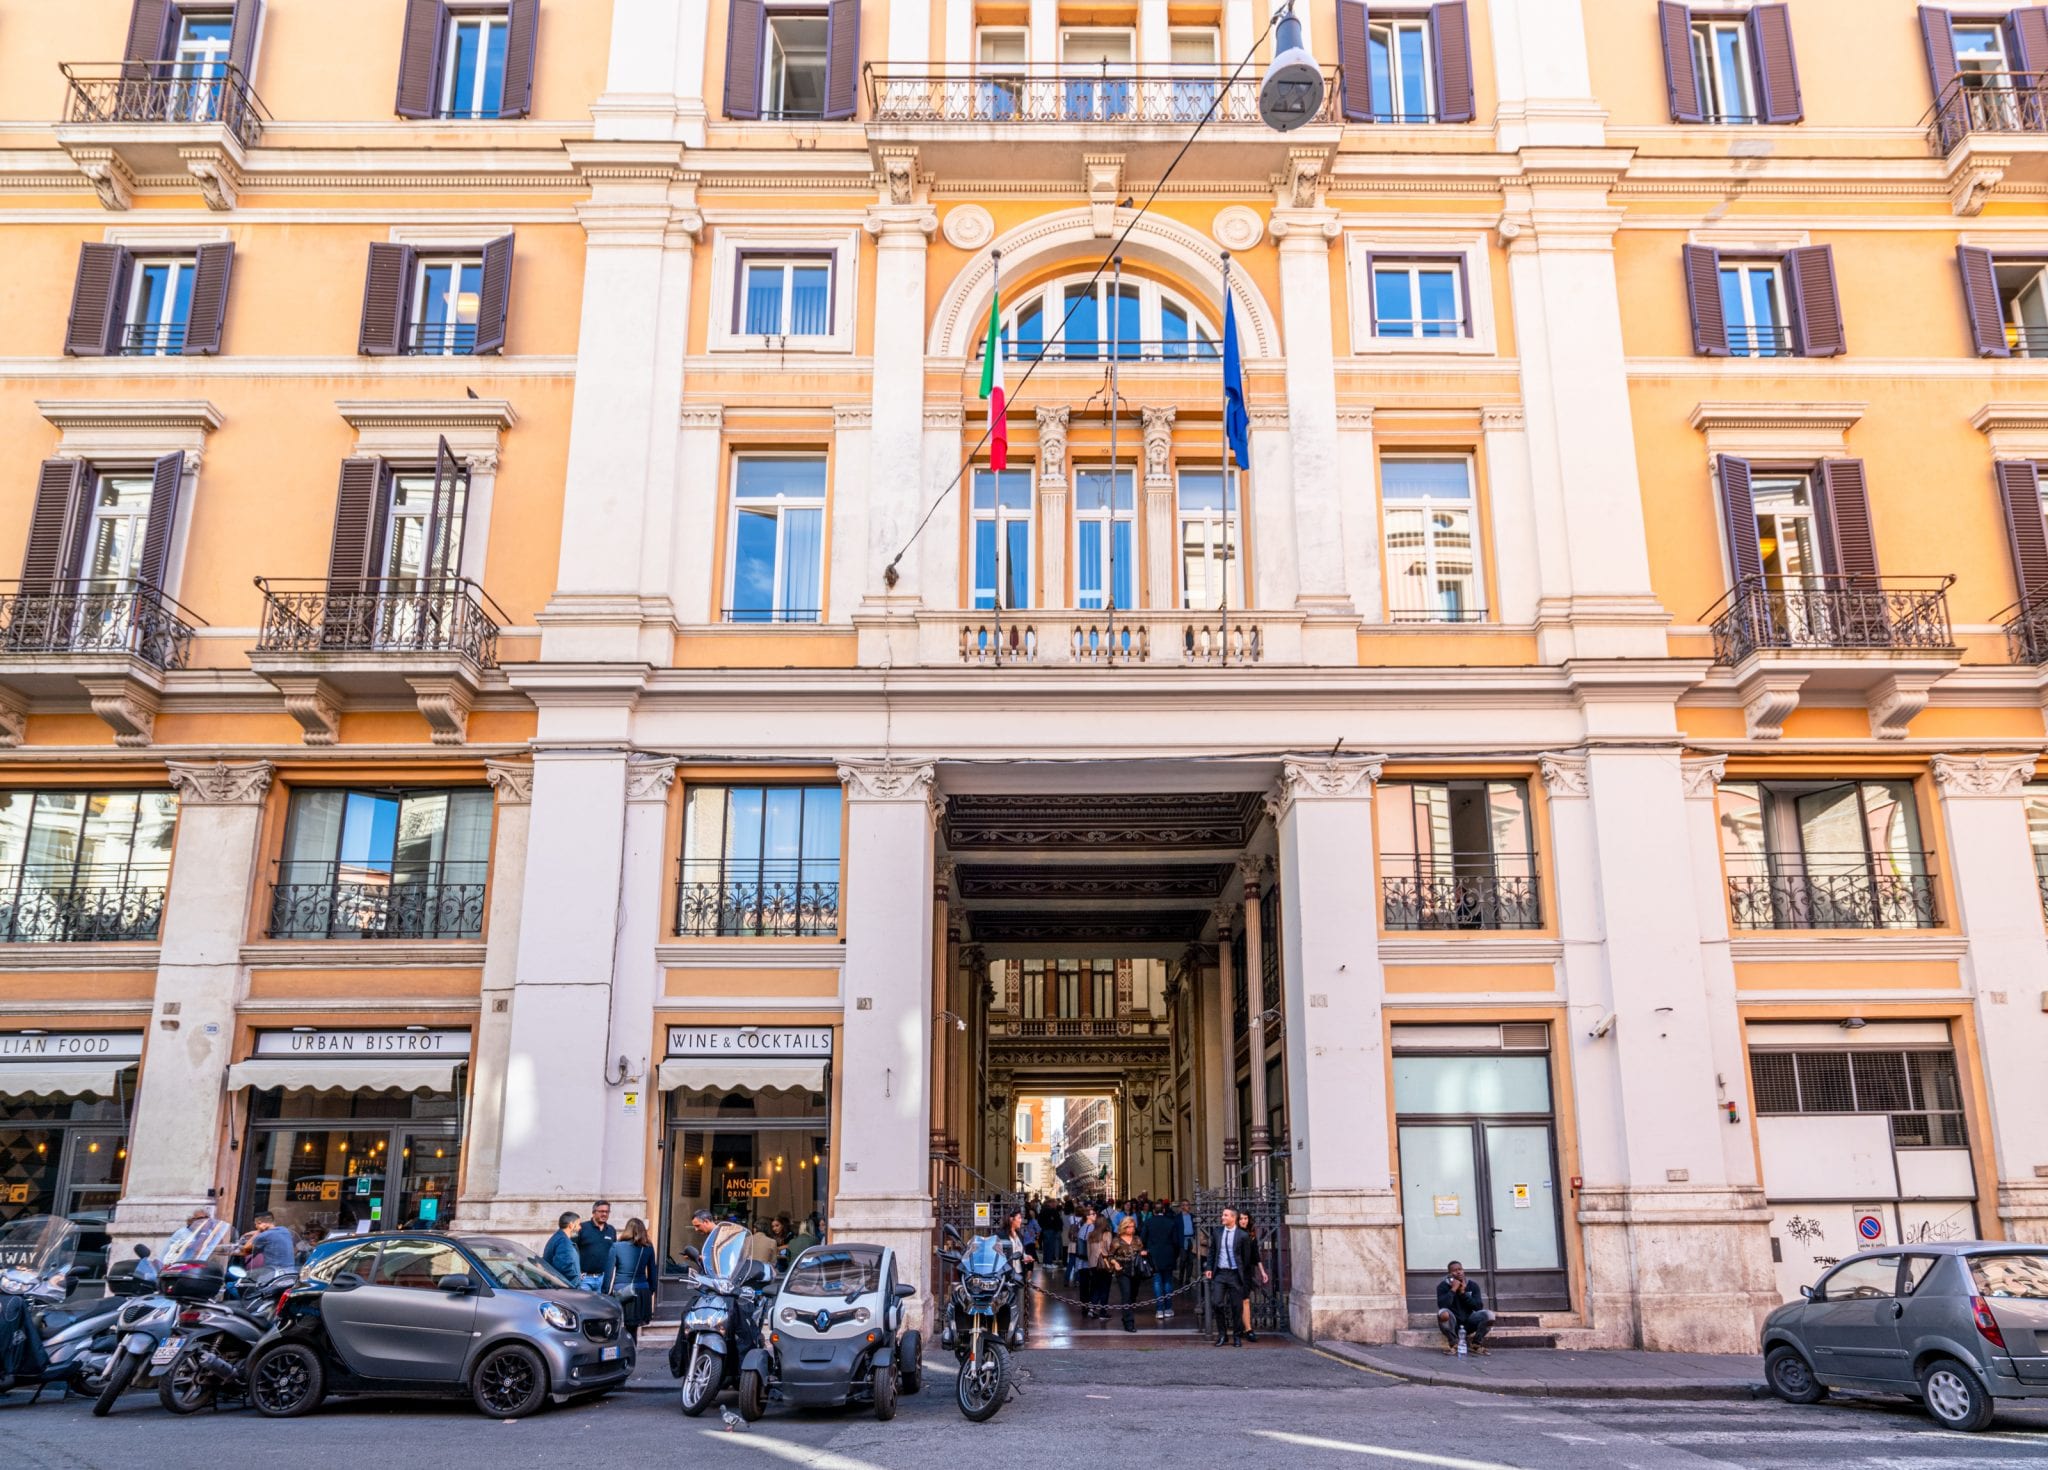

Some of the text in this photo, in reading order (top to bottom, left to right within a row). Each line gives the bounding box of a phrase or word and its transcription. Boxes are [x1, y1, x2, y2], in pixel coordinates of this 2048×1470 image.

[59, 1038, 110, 1053] FOOD
[291, 1035, 443, 1050] URBAN BISTROT
[672, 1033, 829, 1048] WINE & COCKTAILS
